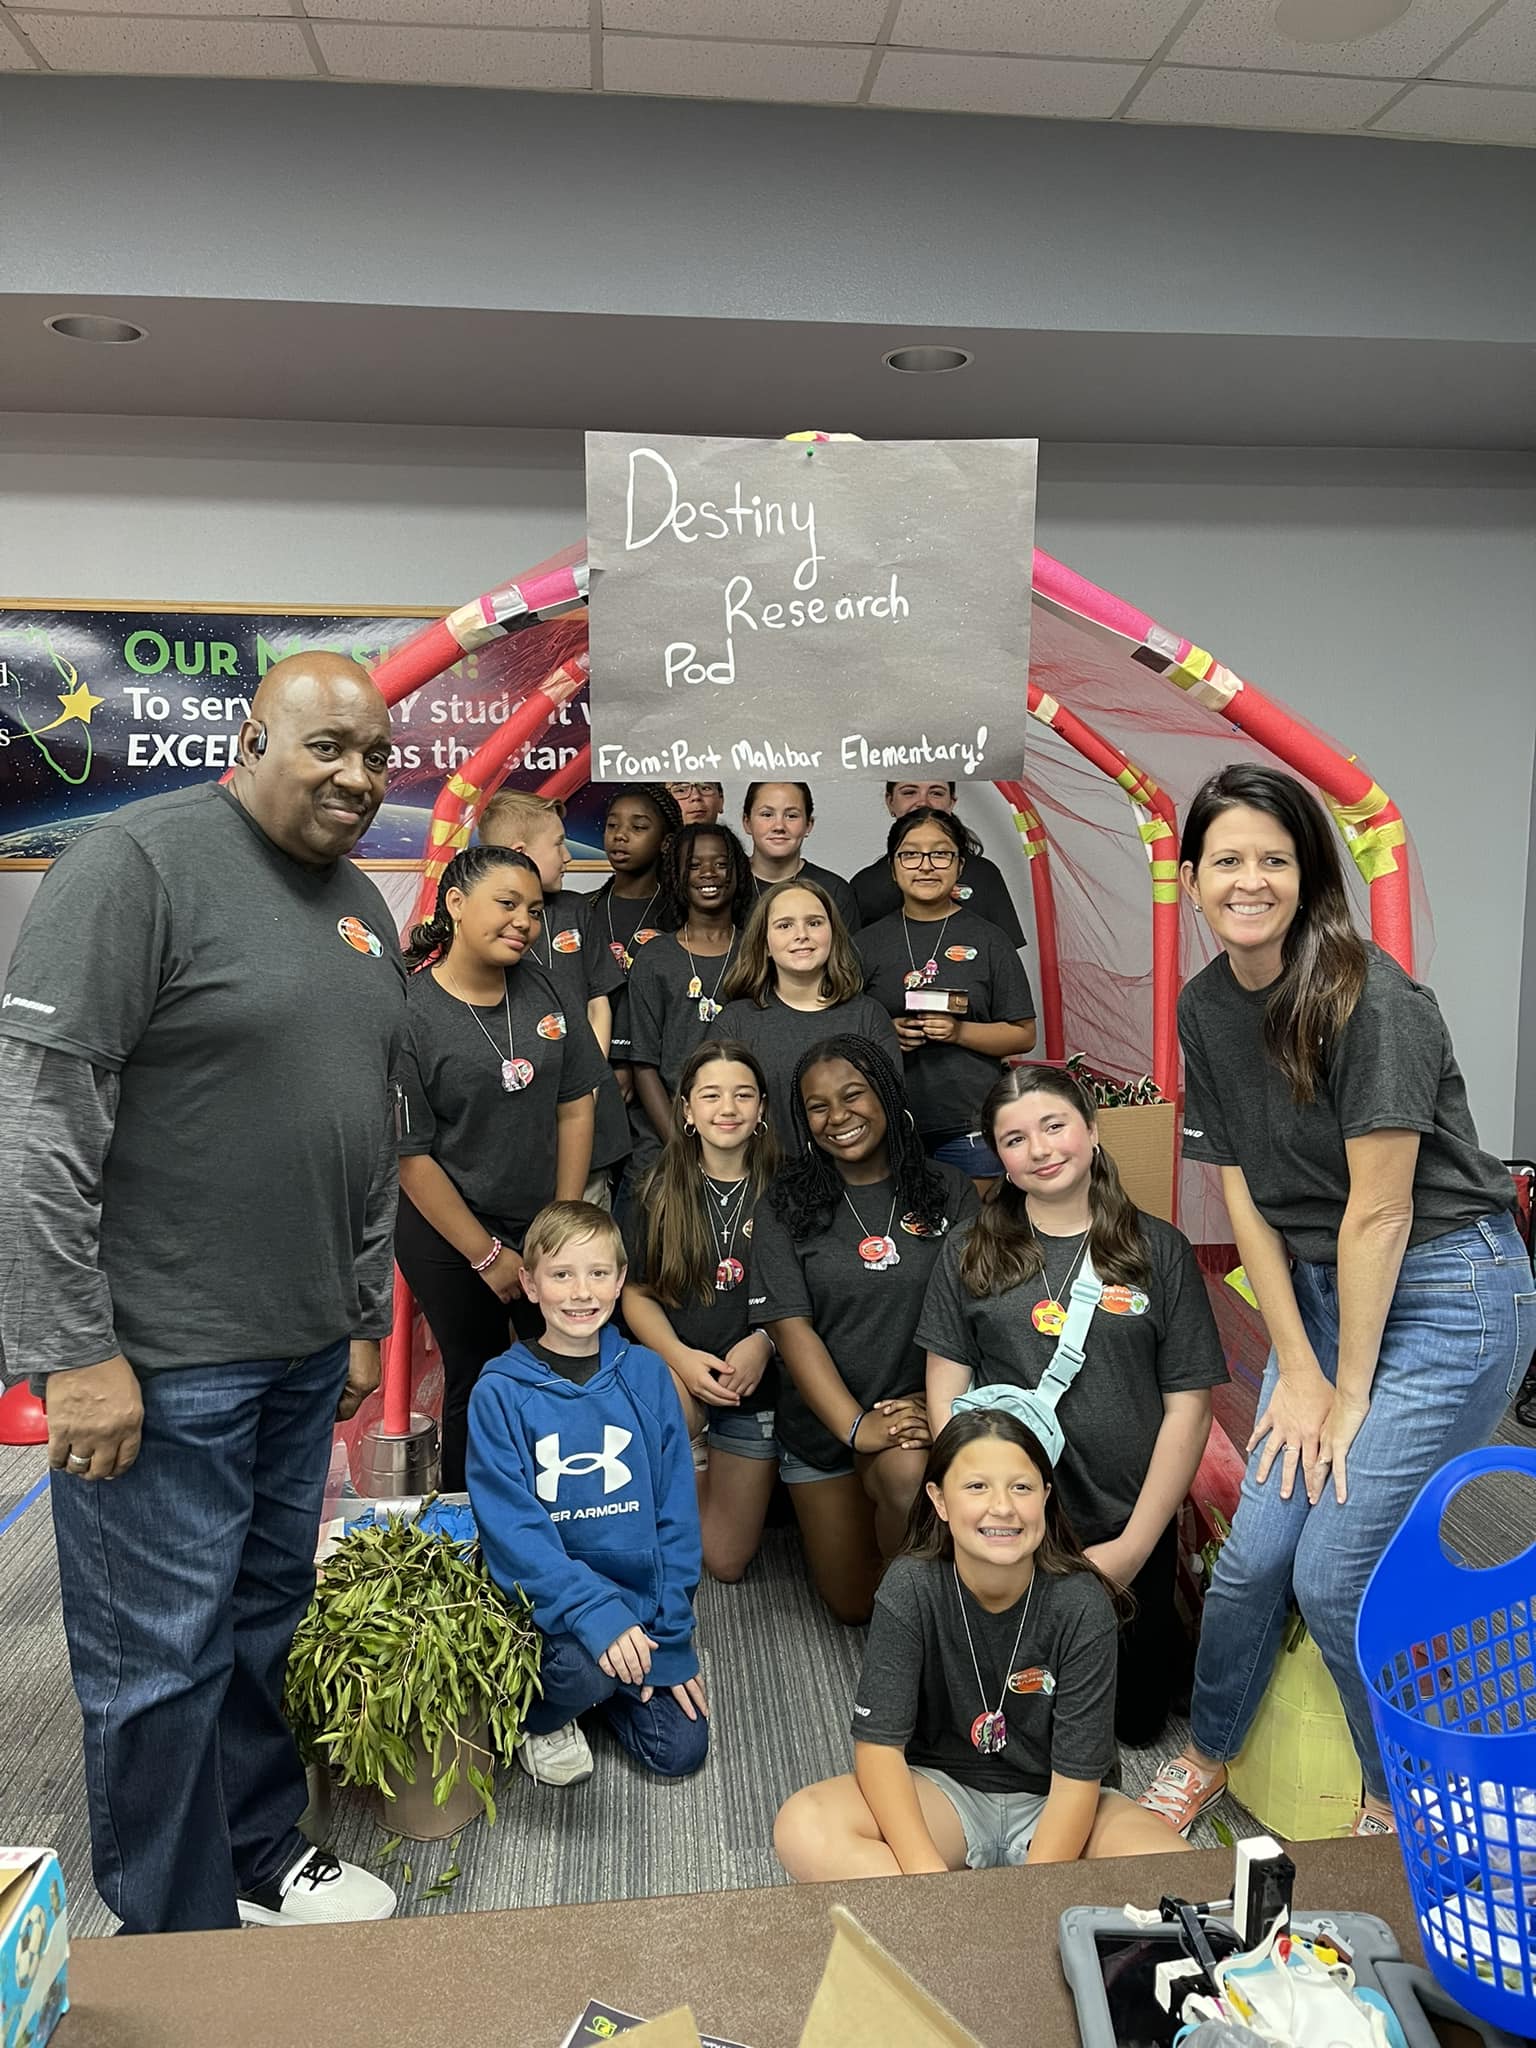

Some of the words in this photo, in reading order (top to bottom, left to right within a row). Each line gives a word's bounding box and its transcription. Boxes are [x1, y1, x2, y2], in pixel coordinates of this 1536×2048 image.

[625, 447, 826, 590] Destiny
[725, 574, 909, 634] Research
[664, 638, 736, 688] Pod
[123, 687, 170, 720] To
[182, 696, 252, 721] serv
[387, 745, 421, 769] as
[431, 737, 482, 769] th
[731, 741, 823, 770] Malabar
[841, 726, 987, 775] Elementary!
[573, 1500, 640, 1520] ARMOUR
